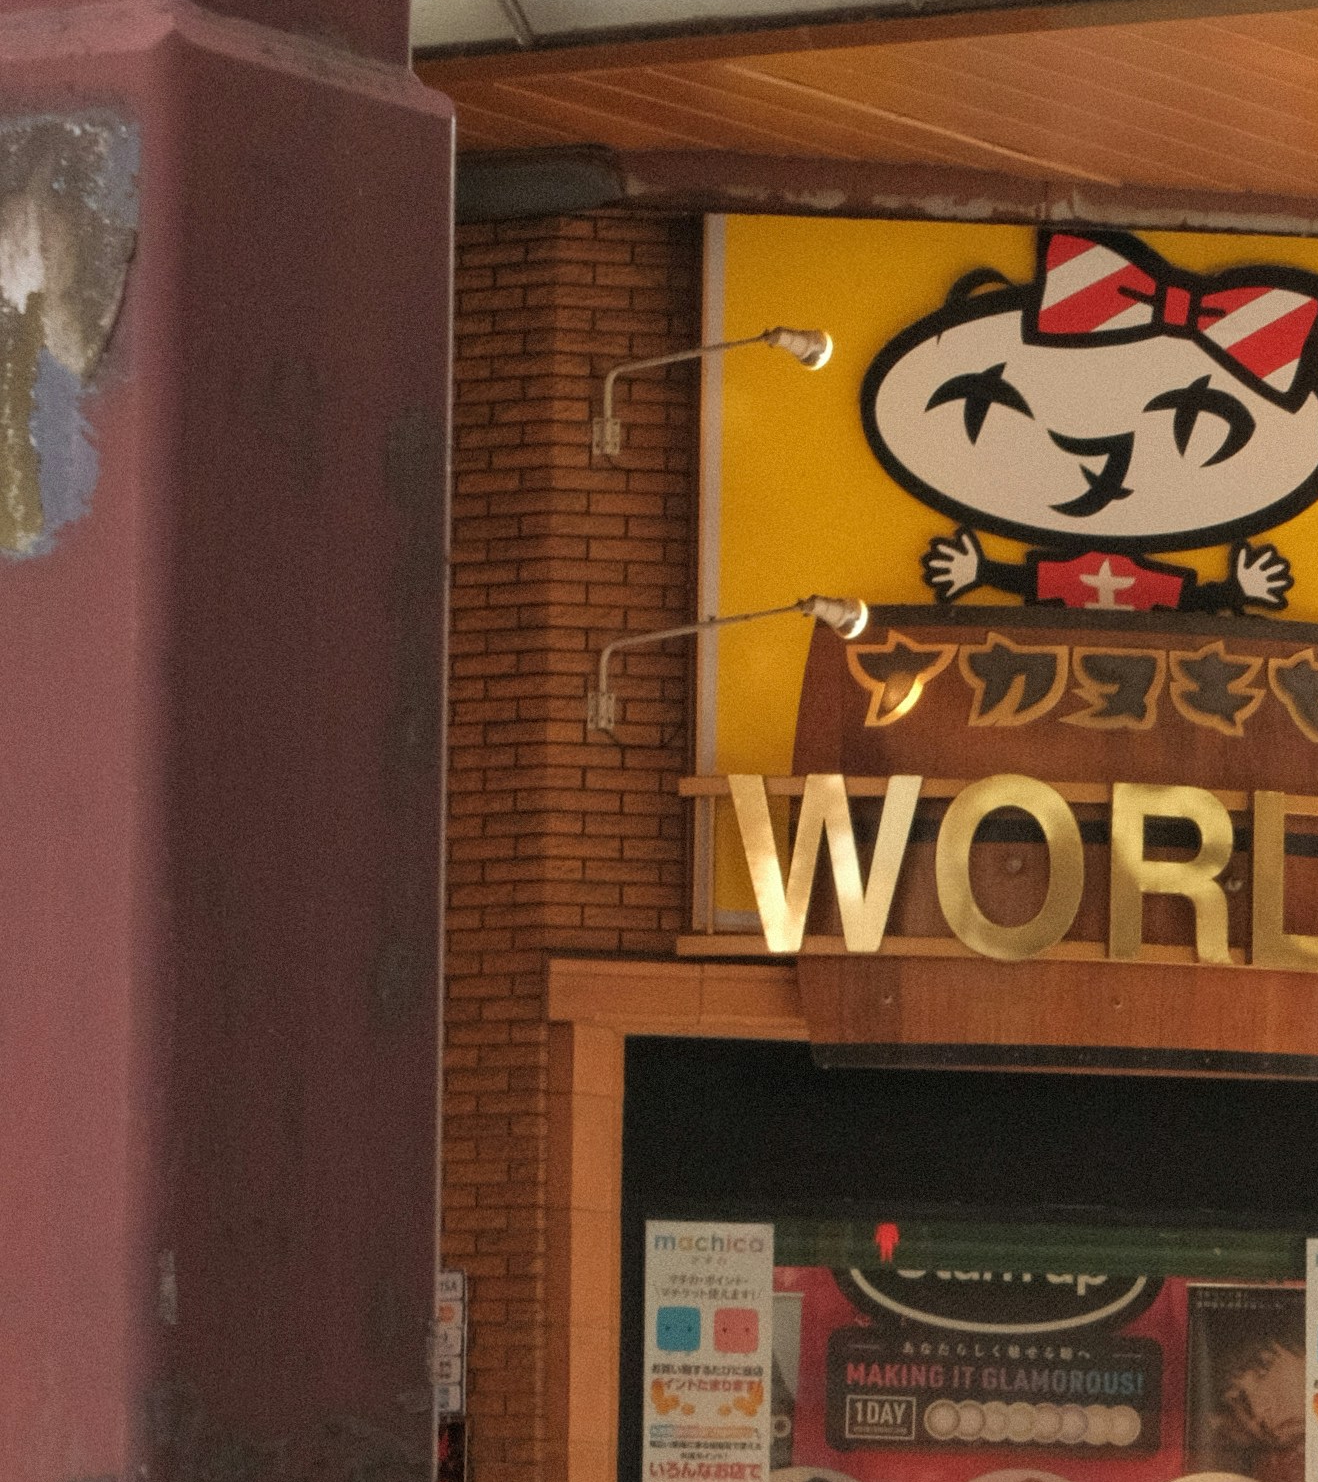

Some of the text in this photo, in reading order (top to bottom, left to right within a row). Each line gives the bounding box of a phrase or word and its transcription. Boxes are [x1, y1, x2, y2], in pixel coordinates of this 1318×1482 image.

[653, 1231, 765, 1253] machica
[846, 1362, 1145, 1395] MAKING IT GLAMOROUS!
[855, 1401, 906, 1425] 1DAY
[649, 1462, 763, 1482] いろんなお店で
